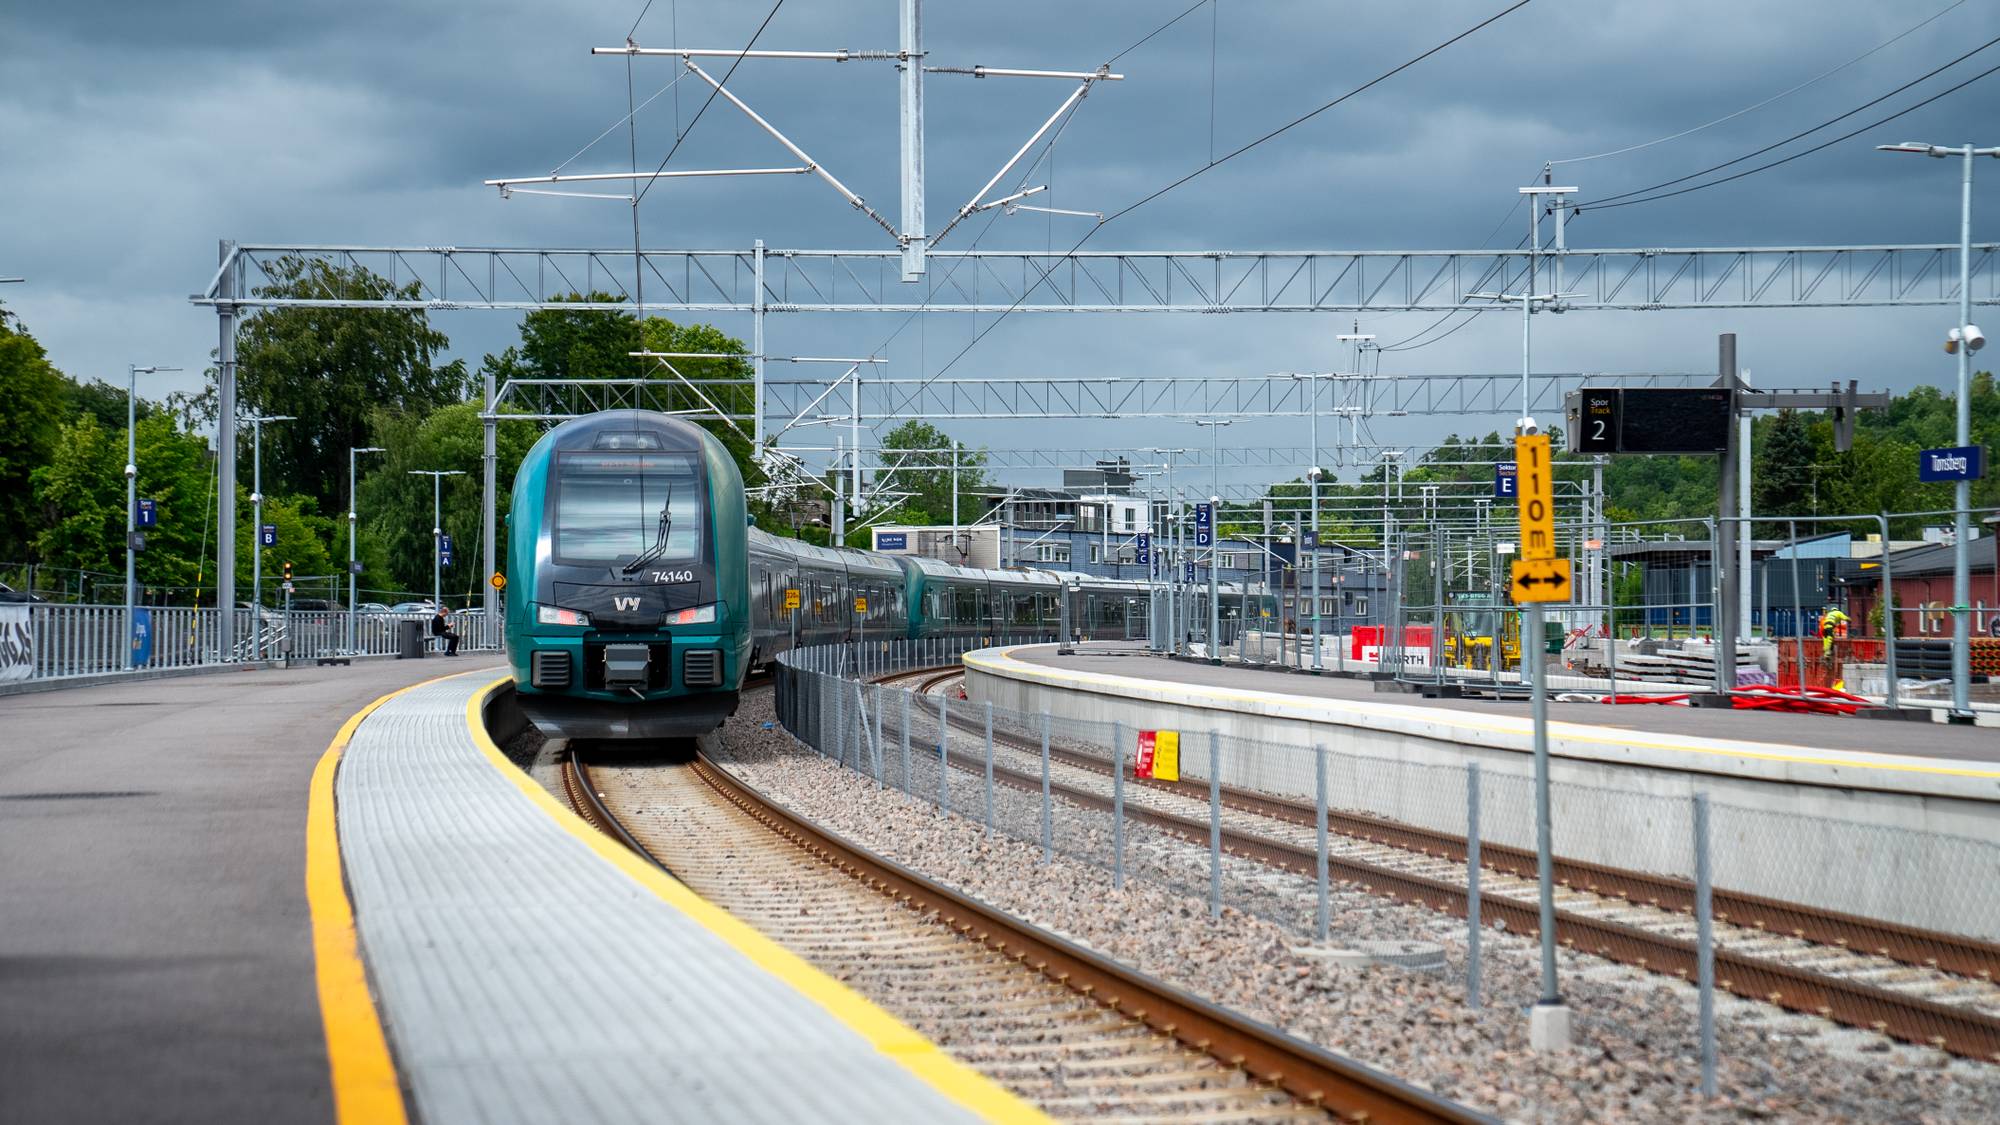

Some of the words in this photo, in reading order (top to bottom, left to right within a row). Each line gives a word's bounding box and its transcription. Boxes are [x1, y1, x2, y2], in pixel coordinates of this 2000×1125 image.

[1590, 398, 1608, 407] Spor
[1590, 407, 1611, 415] Track
[1591, 420, 1606, 440] 2
[1502, 478, 1512, 493] E
[143, 511, 148, 523] 1
[1200, 512, 1207, 522] 2
[265, 533, 273, 544] B
[1200, 533, 1208, 543] D
[442, 557, 449, 565] A
[652, 570, 693, 583] 74140
